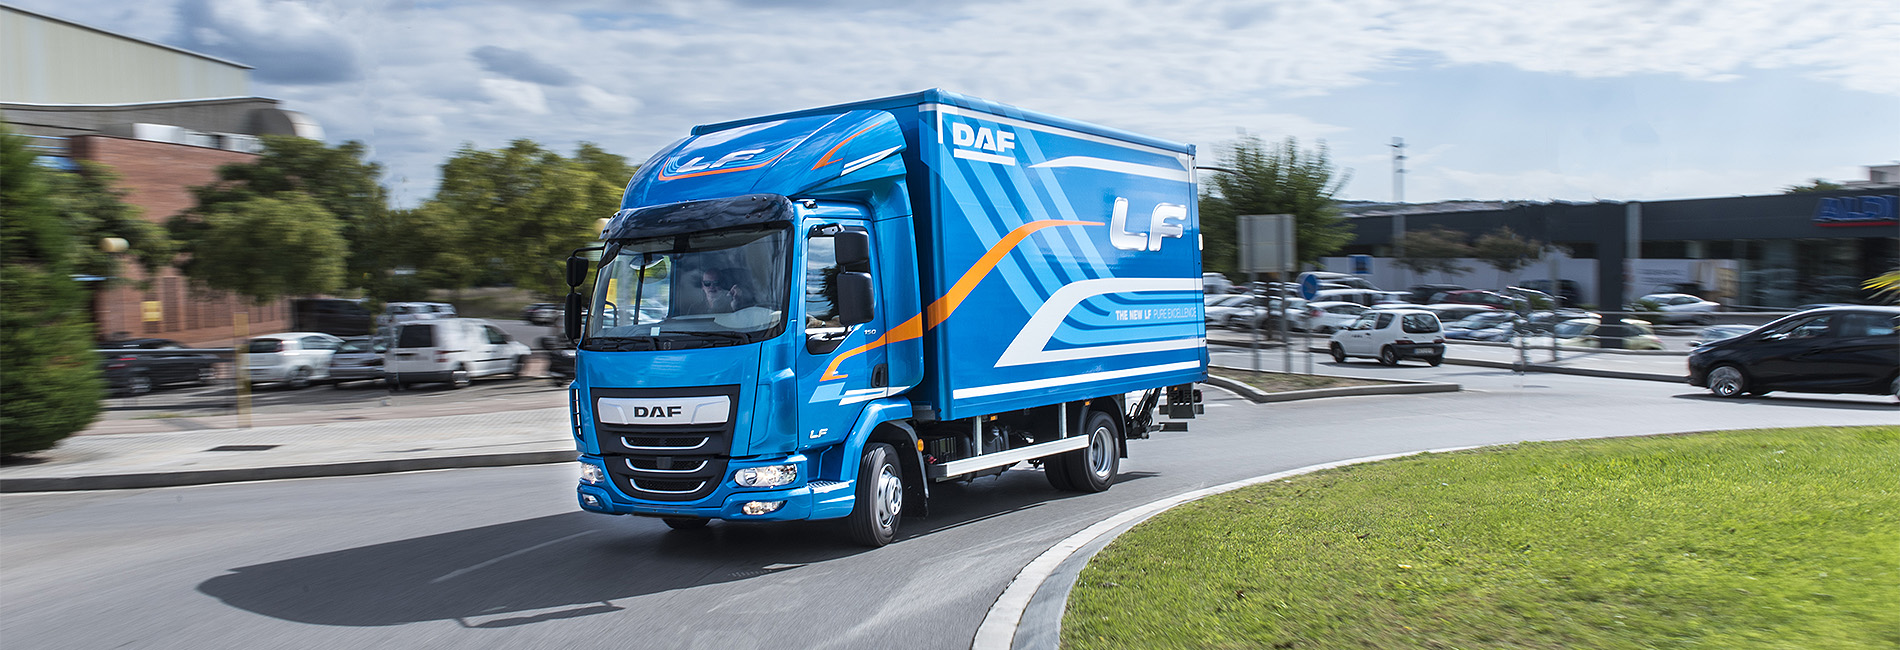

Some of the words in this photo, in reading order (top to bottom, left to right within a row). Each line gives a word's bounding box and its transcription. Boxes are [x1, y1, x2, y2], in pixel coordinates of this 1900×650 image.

[953, 122, 1015, 152] DAF
[675, 148, 766, 172] LF
[1110, 196, 1187, 251] LF
[1115, 310, 1129, 321] THE
[1129, 309, 1143, 320] NEW
[1144, 309, 1152, 320] LF
[1153, 308, 1168, 320] PURE
[1168, 307, 1197, 319] EXCELLENCE
[634, 406, 682, 418] DAF
[809, 428, 828, 439] LF
